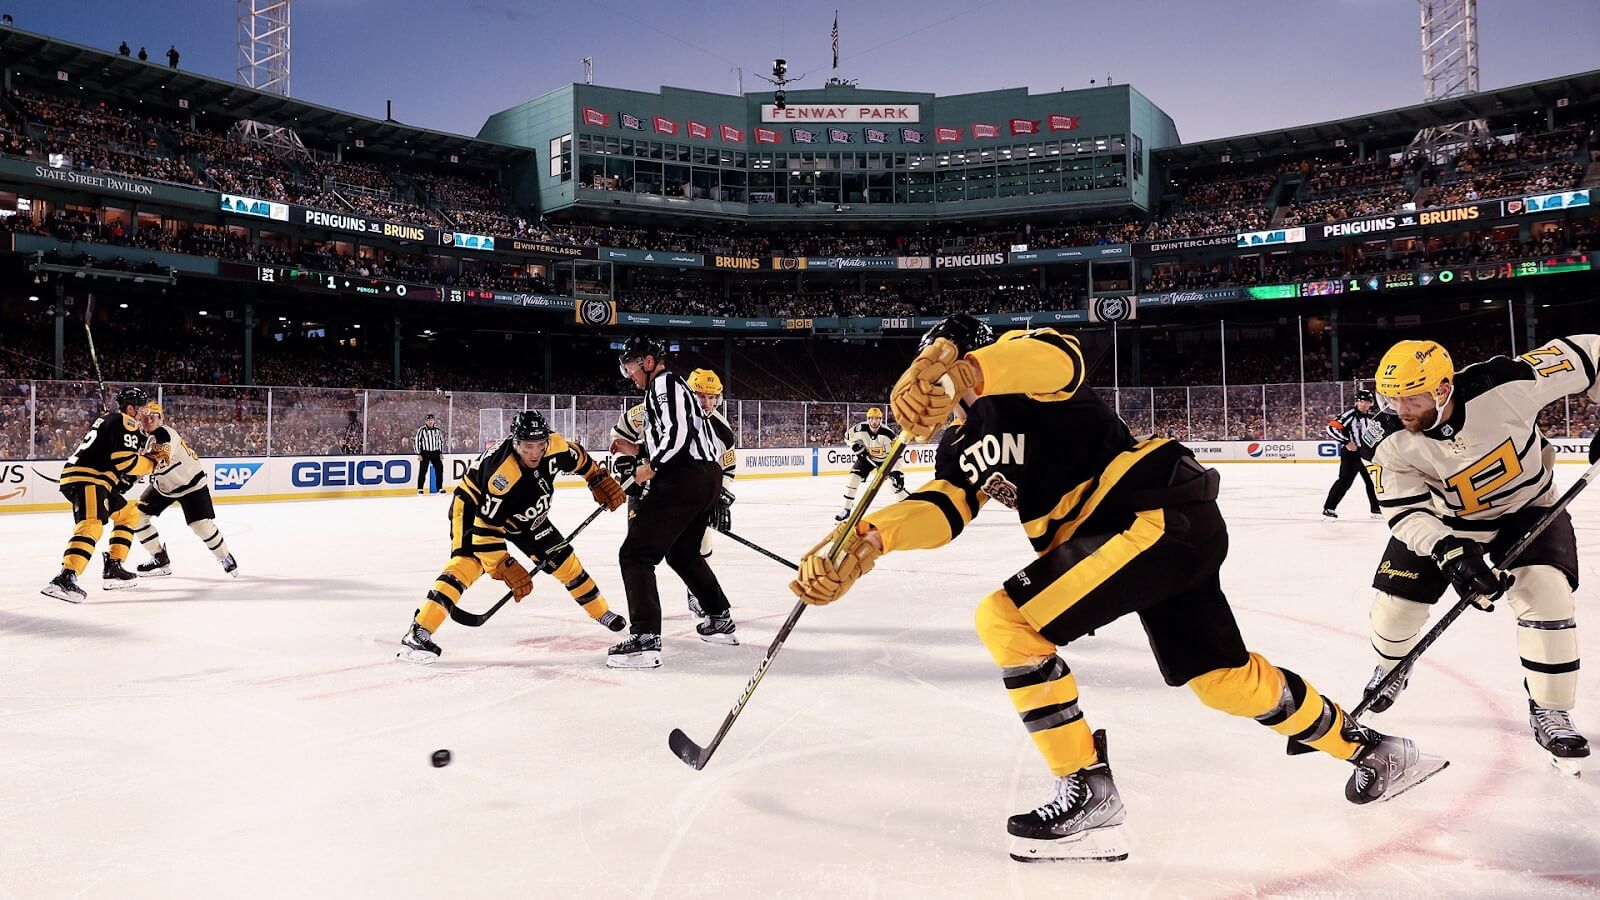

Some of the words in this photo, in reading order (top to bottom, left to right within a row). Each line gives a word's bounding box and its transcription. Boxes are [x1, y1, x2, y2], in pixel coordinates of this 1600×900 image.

[772, 108, 847, 118] FENWAY
[860, 108, 908, 118] PARK
[36, 166, 67, 181] STATE
[68, 172, 105, 187] STREET
[107, 177, 153, 195] PAVILION
[305, 210, 366, 231] PENGUINS
[384, 223, 425, 241] BRUINS
[1323, 217, 1396, 238] PENGUINS
[1420, 206, 1479, 226] BRUINS
[521, 242, 582, 256] WINTERCLASSIC
[1160, 236, 1237, 251] WINTERCLASSIC
[715, 255, 760, 270] BRUINS
[836, 257, 867, 270] Winter
[935, 252, 1005, 269] PENGUINS
[261, 273, 275, 282] 21
[1386, 272, 1413, 283] 17:02
[1438, 270, 1454, 283] 0
[1520, 267, 1538, 276] 19
[327, 276, 337, 289] 1
[1349, 280, 1361, 292] 1
[396, 284, 407, 297] 0
[520, 293, 550, 307] Winter
[1169, 291, 1204, 305] Winter
[123, 433, 138, 449] 92
[1265, 442, 1295, 452] pepsi
[745, 455, 757, 467] NEW
[758, 455, 790, 467] AMSTERDAM
[828, 450, 855, 464] Great
[548, 457, 559, 475] C
[214, 467, 252, 486] SAP
[291, 459, 412, 488] GEICO
[1445, 436, 1524, 517] P
[481, 493, 503, 519] 37
[513, 493, 551, 522] BOST
[1377, 560, 1420, 579] Penguins
